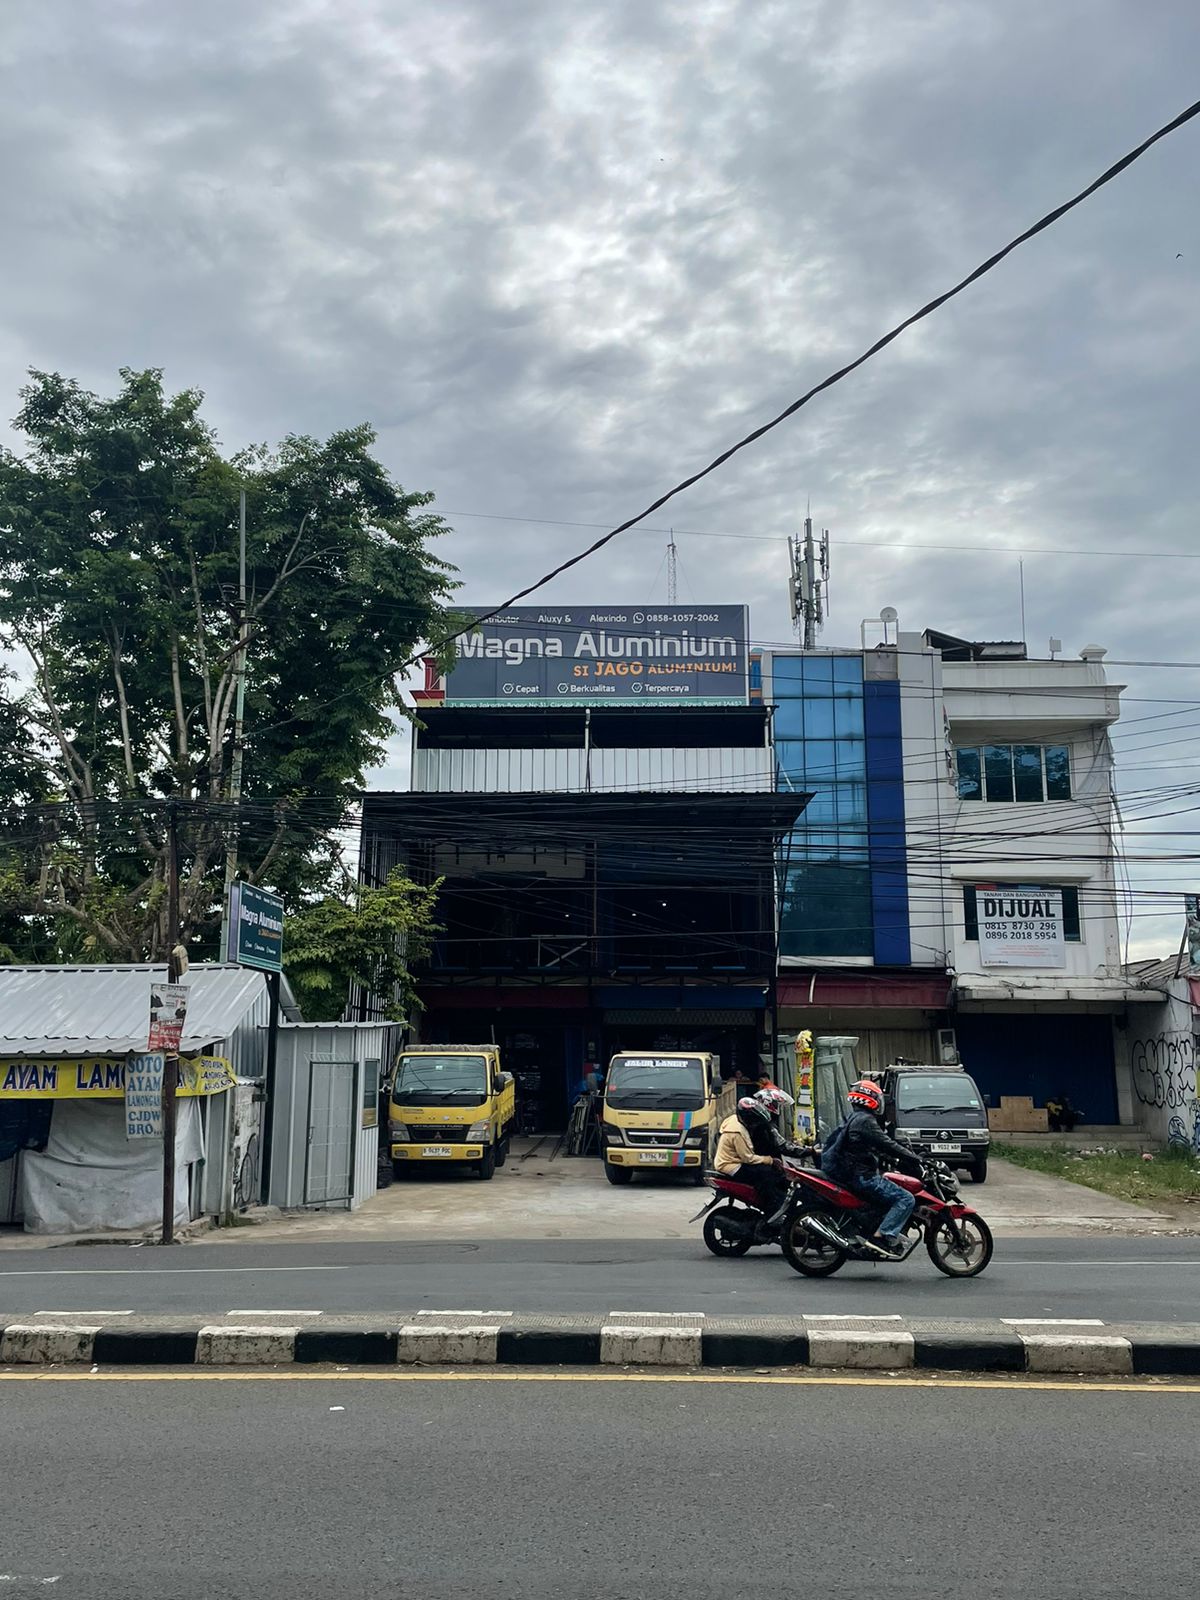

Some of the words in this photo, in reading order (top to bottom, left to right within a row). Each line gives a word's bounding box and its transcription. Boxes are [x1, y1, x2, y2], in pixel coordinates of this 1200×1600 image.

[538, 614, 562, 625] Aluxy
[565, 614, 572, 623] &
[589, 613, 627, 623] Alexindo
[647, 613, 719, 623] 0858-1057-2062
[455, 631, 562, 666] Magna
[573, 629, 737, 658] Aluminium
[573, 664, 589, 678] SI
[594, 661, 643, 677] JAGO
[648, 661, 737, 675] ALUMINIUM!
[515, 684, 540, 694] Cepat
[570, 683, 616, 693] Berkualitas
[645, 683, 690, 694] Terpercaya
[241, 904, 259, 926] Magna
[984, 898, 1055, 918] DIJUAL
[985, 922, 1007, 930] 0815
[1012, 922, 1035, 930] 8730
[1039, 922, 1057, 930] 296
[985, 931, 1008, 940] 0896
[1010, 931, 1032, 940] 2018
[1034, 931, 1057, 940] 5954
[127, 1056, 163, 1073] SOTO
[1, 1063, 60, 1091] AYAM
[127, 1075, 162, 1092] AYAM
[127, 1095, 161, 1107] LAMONGAN
[128, 1111, 161, 1122] CJDW
